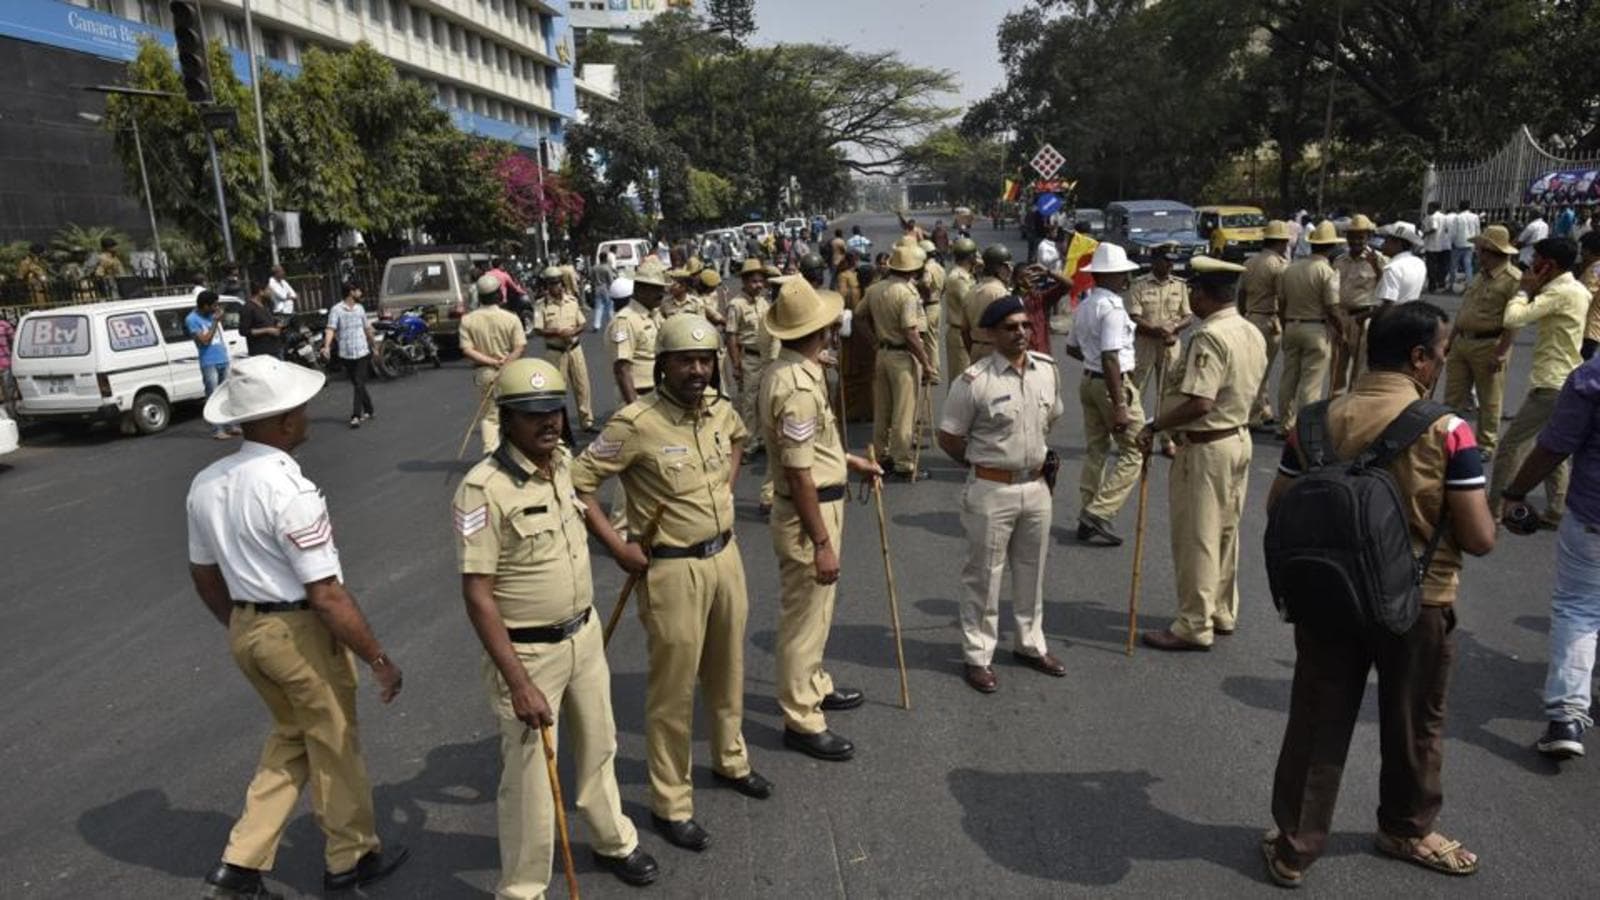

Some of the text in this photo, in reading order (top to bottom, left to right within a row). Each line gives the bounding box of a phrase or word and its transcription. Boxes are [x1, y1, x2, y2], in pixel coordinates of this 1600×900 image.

[68, 11, 117, 38] Canara
[34, 320, 77, 344] Btv
[111, 320, 148, 338] Btv
